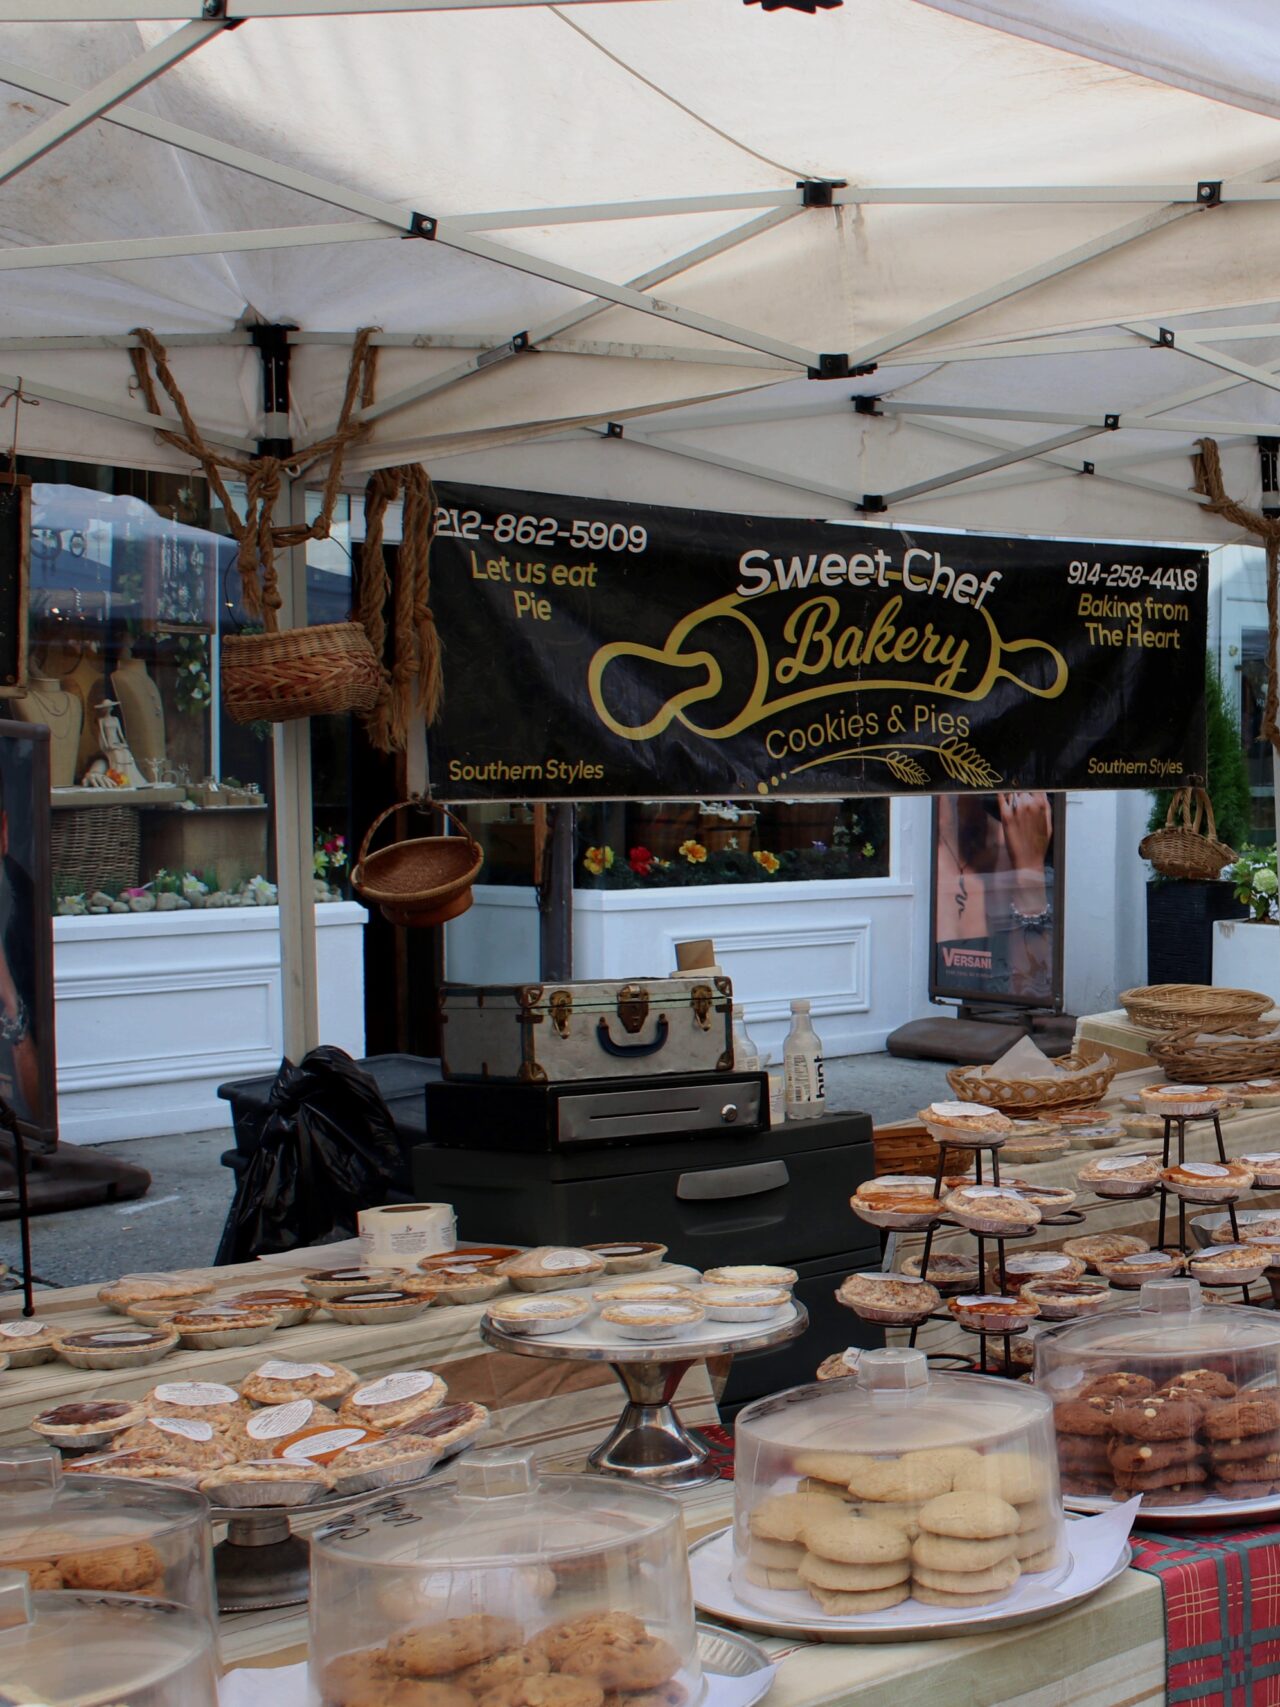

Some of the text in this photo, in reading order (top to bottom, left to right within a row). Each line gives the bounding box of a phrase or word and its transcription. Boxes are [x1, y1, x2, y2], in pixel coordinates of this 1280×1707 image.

[433, 507, 648, 554] 212-862-5909
[470, 550, 598, 588] Let us eat
[736, 548, 1003, 610] Sweet Chef
[1067, 560, 1198, 591] 914-258-4418
[513, 590, 552, 621] Pie
[1078, 593, 1189, 626] Baking from
[775, 595, 970, 694] Bakery
[1084, 623, 1180, 649] The Heart
[765, 704, 970, 760] Cookies & Pies
[449, 758, 605, 785] Southern Styles
[1087, 757, 1184, 777] Southern Styles
[942, 947, 992, 970] VERSANI
[814, 1055, 825, 1099] hint
